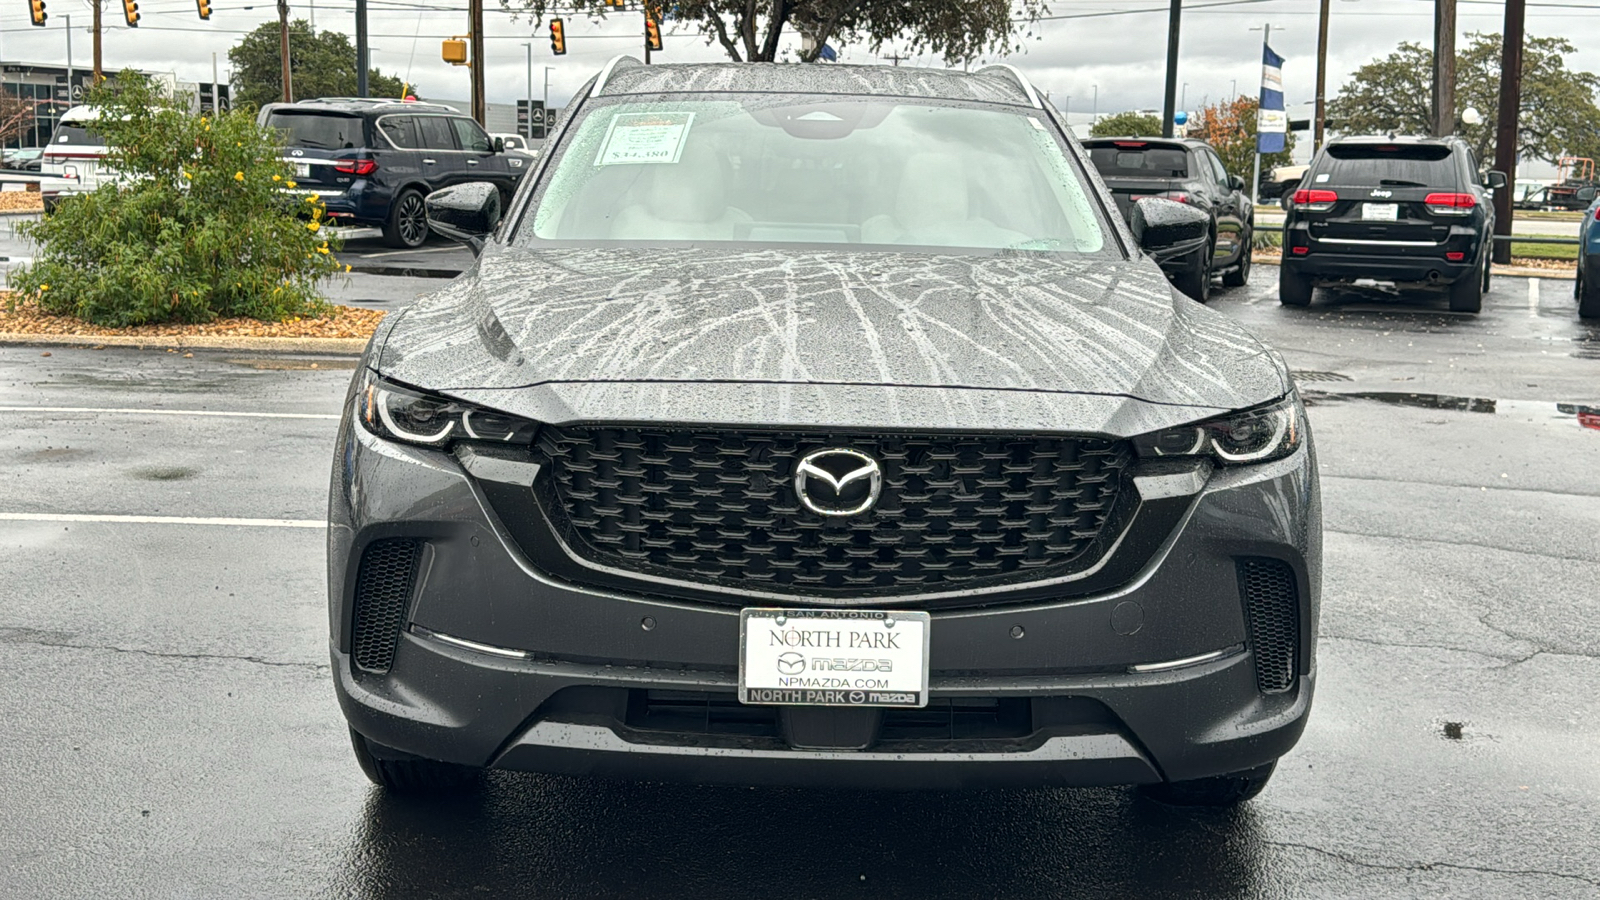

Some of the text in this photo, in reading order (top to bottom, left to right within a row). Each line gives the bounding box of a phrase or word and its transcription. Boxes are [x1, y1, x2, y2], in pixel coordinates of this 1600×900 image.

[1370, 189, 1392, 199] Jeep
[820, 611, 884, 619] ANTONIO
[769, 629, 901, 650] NORTH PARK
[778, 677, 889, 689] NPMAZDA.COM
[751, 689, 802, 702] NORTH
[806, 691, 846, 703] PARK
